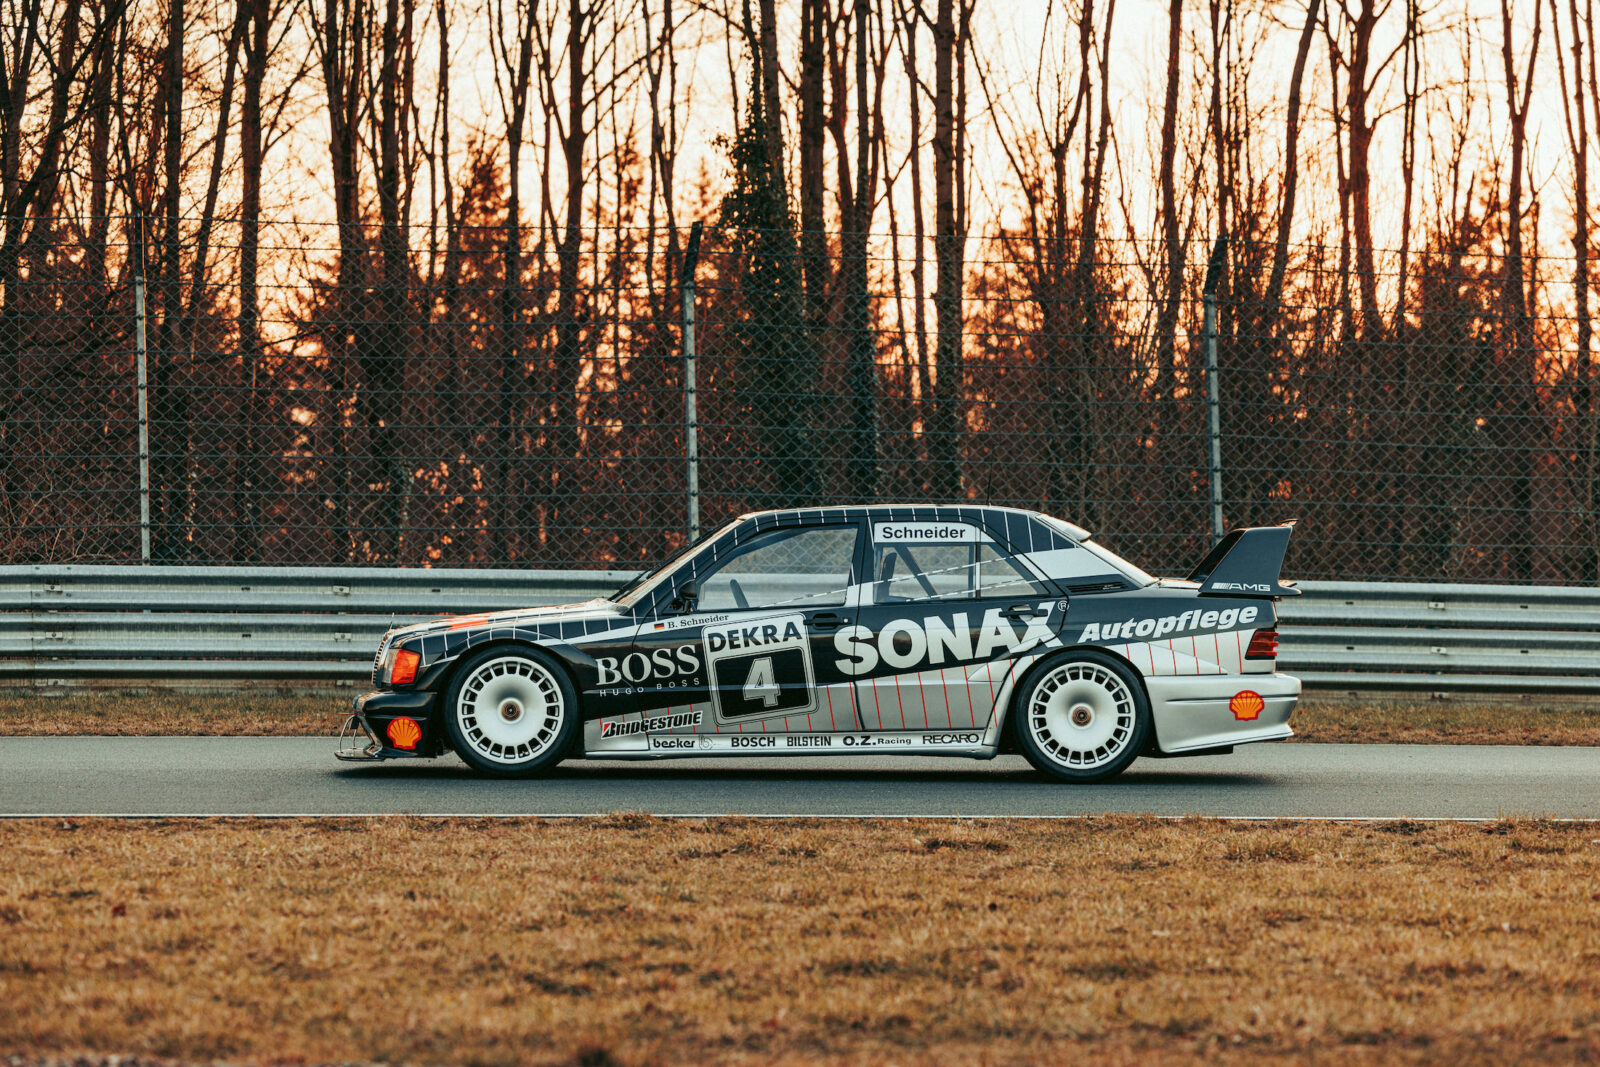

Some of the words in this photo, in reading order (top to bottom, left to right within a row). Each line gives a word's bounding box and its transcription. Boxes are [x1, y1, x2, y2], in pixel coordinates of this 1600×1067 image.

[882, 526, 966, 540] Schneider
[1229, 582, 1271, 592] AMG
[667, 621, 677, 629] B.
[680, 614, 729, 627] Schneider
[1077, 606, 1259, 644] Autopflege
[708, 621, 803, 653] DEKRA
[833, 601, 1064, 675] SONAX
[596, 644, 700, 686] BOSS
[599, 686, 645, 697] HUGO
[656, 678, 700, 690] BOSS
[743, 656, 781, 708] 4
[601, 711, 703, 739] BRIDGESTONE
[653, 738, 696, 749] becker
[731, 736, 776, 748] BOSCH
[786, 736, 832, 747] BILSTEIN
[842, 735, 877, 746] O.Z.
[877, 737, 912, 745] Racing
[922, 733, 980, 744] RECARO
